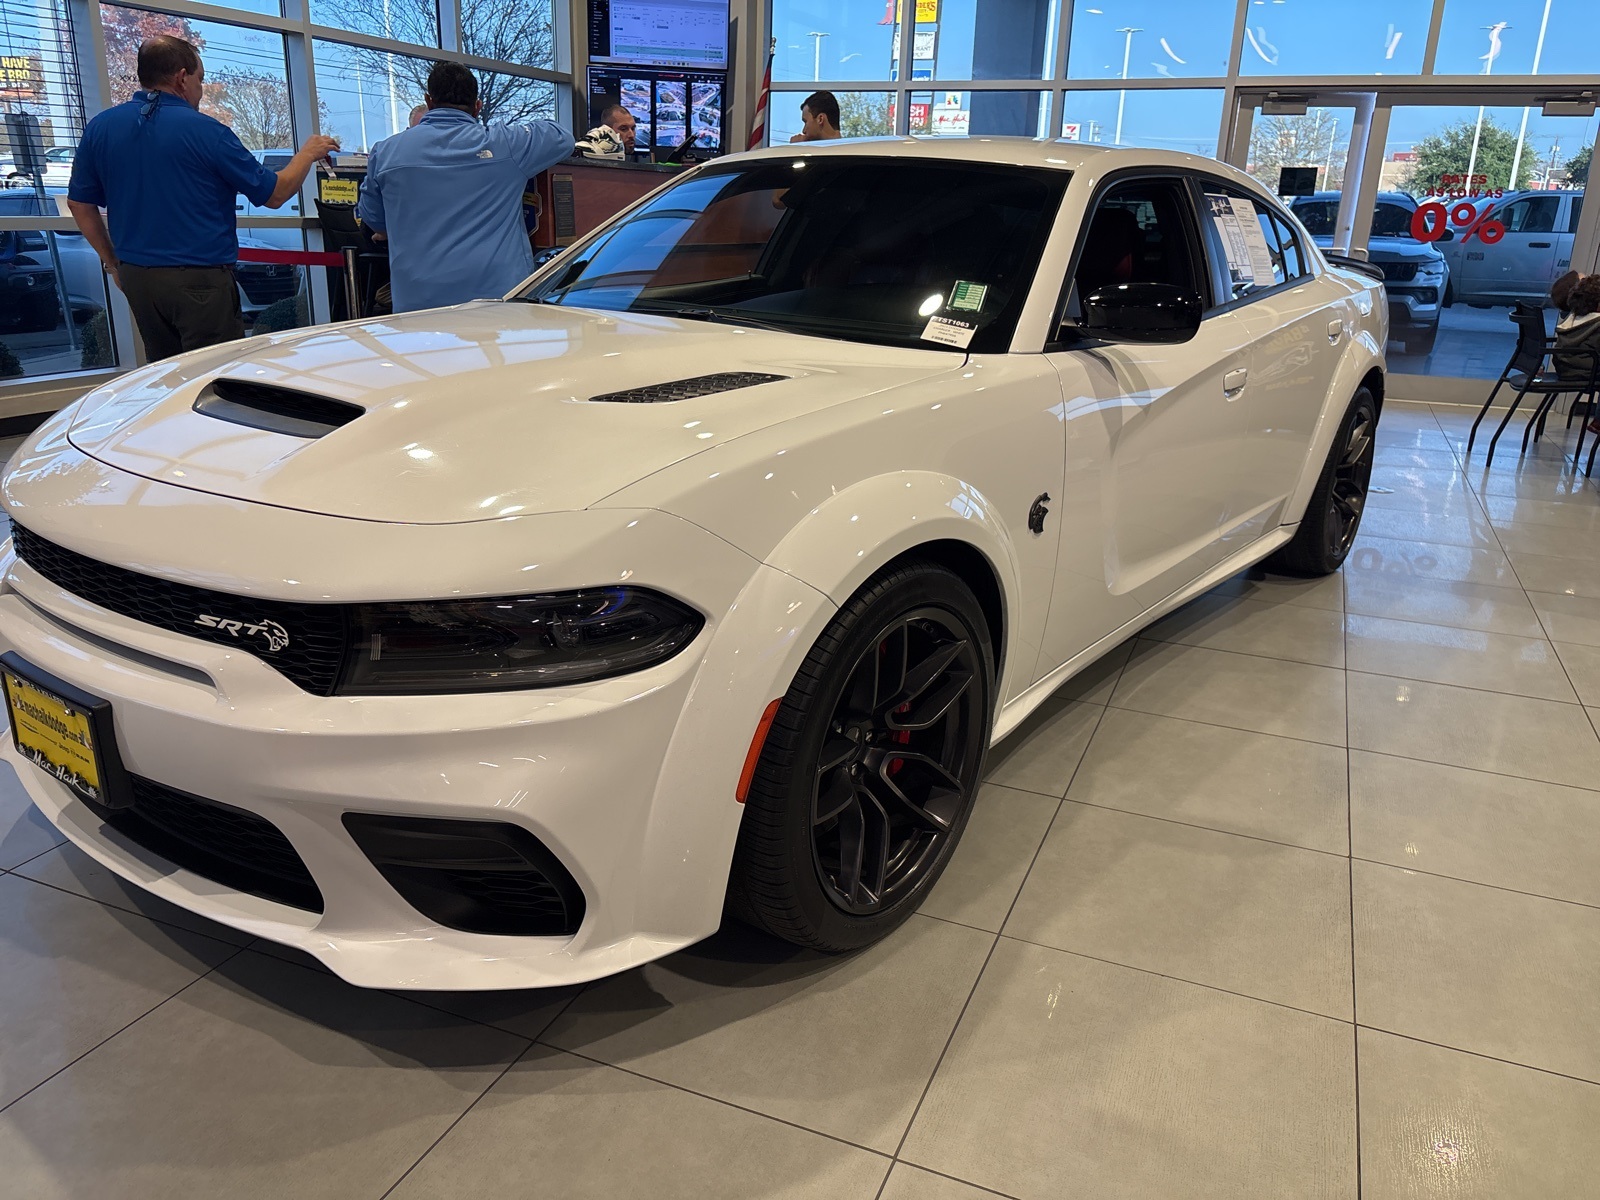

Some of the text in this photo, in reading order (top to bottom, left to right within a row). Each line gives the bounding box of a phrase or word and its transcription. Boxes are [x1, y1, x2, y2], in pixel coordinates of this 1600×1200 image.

[2, 56, 30, 69] HAVE
[1442, 174, 1487, 184] RATES
[1426, 185, 1504, 199] AS LOW AS
[1411, 202, 1505, 245] 0%
[193, 613, 269, 638] SRT
[33, 750, 56, 775] Mac
